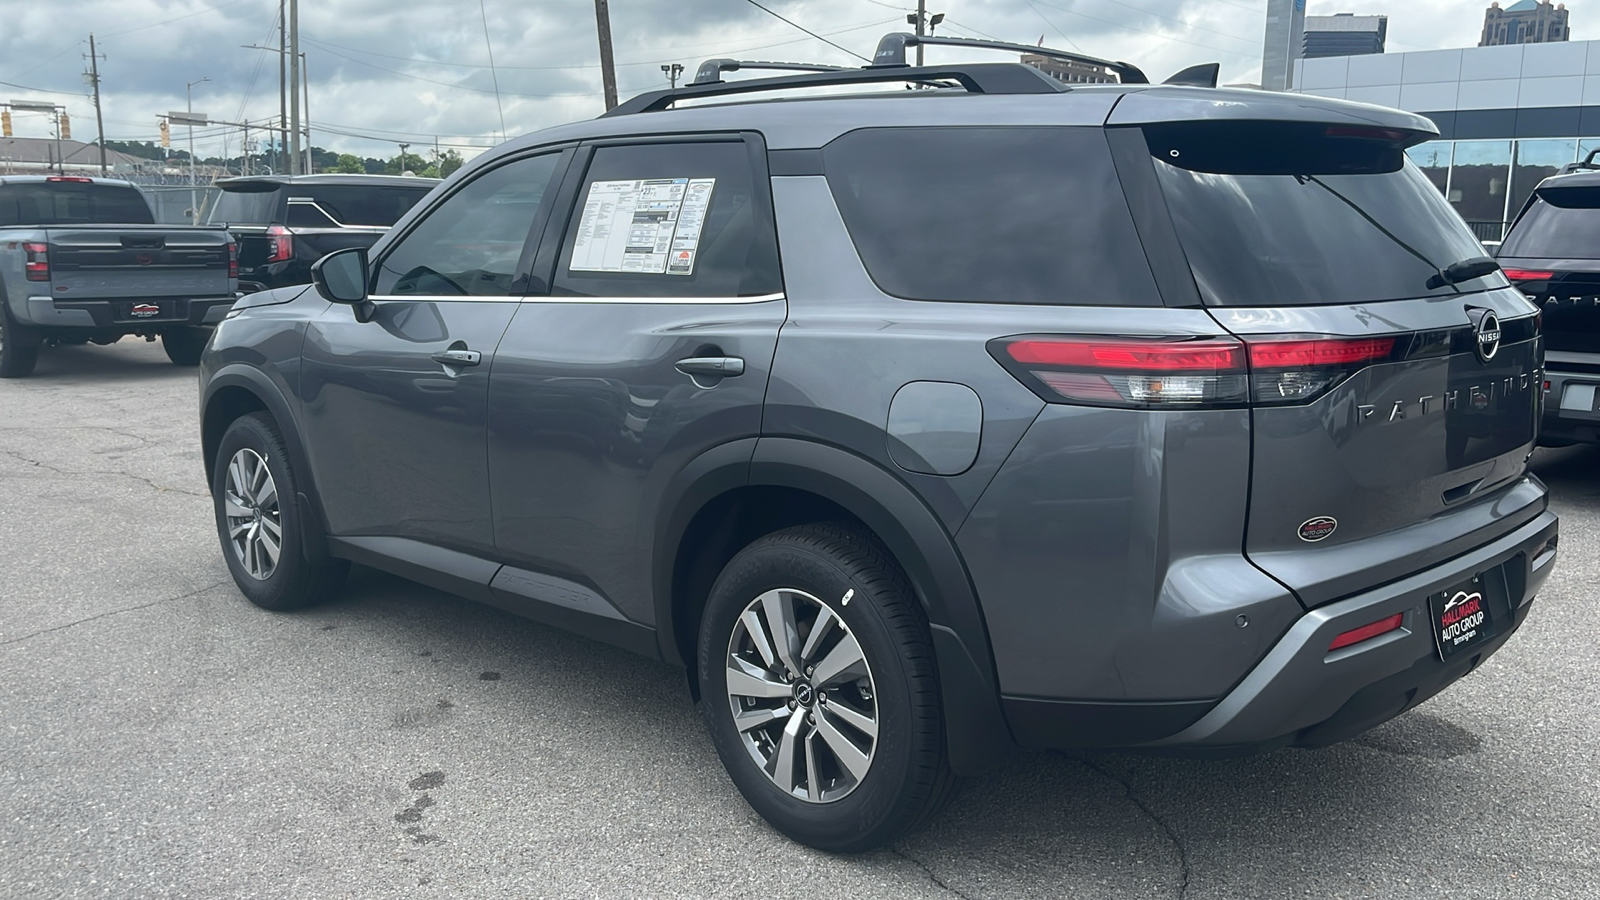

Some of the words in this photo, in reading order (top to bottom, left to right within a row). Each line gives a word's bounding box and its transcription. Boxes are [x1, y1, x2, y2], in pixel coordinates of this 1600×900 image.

[1357, 368, 1540, 426] PATHFINDE
[1441, 597, 1481, 628] HALLMARK
[1442, 622, 1461, 643] AUTO
[1460, 611, 1484, 632] GROUP
[1453, 629, 1477, 646] Birmingham
